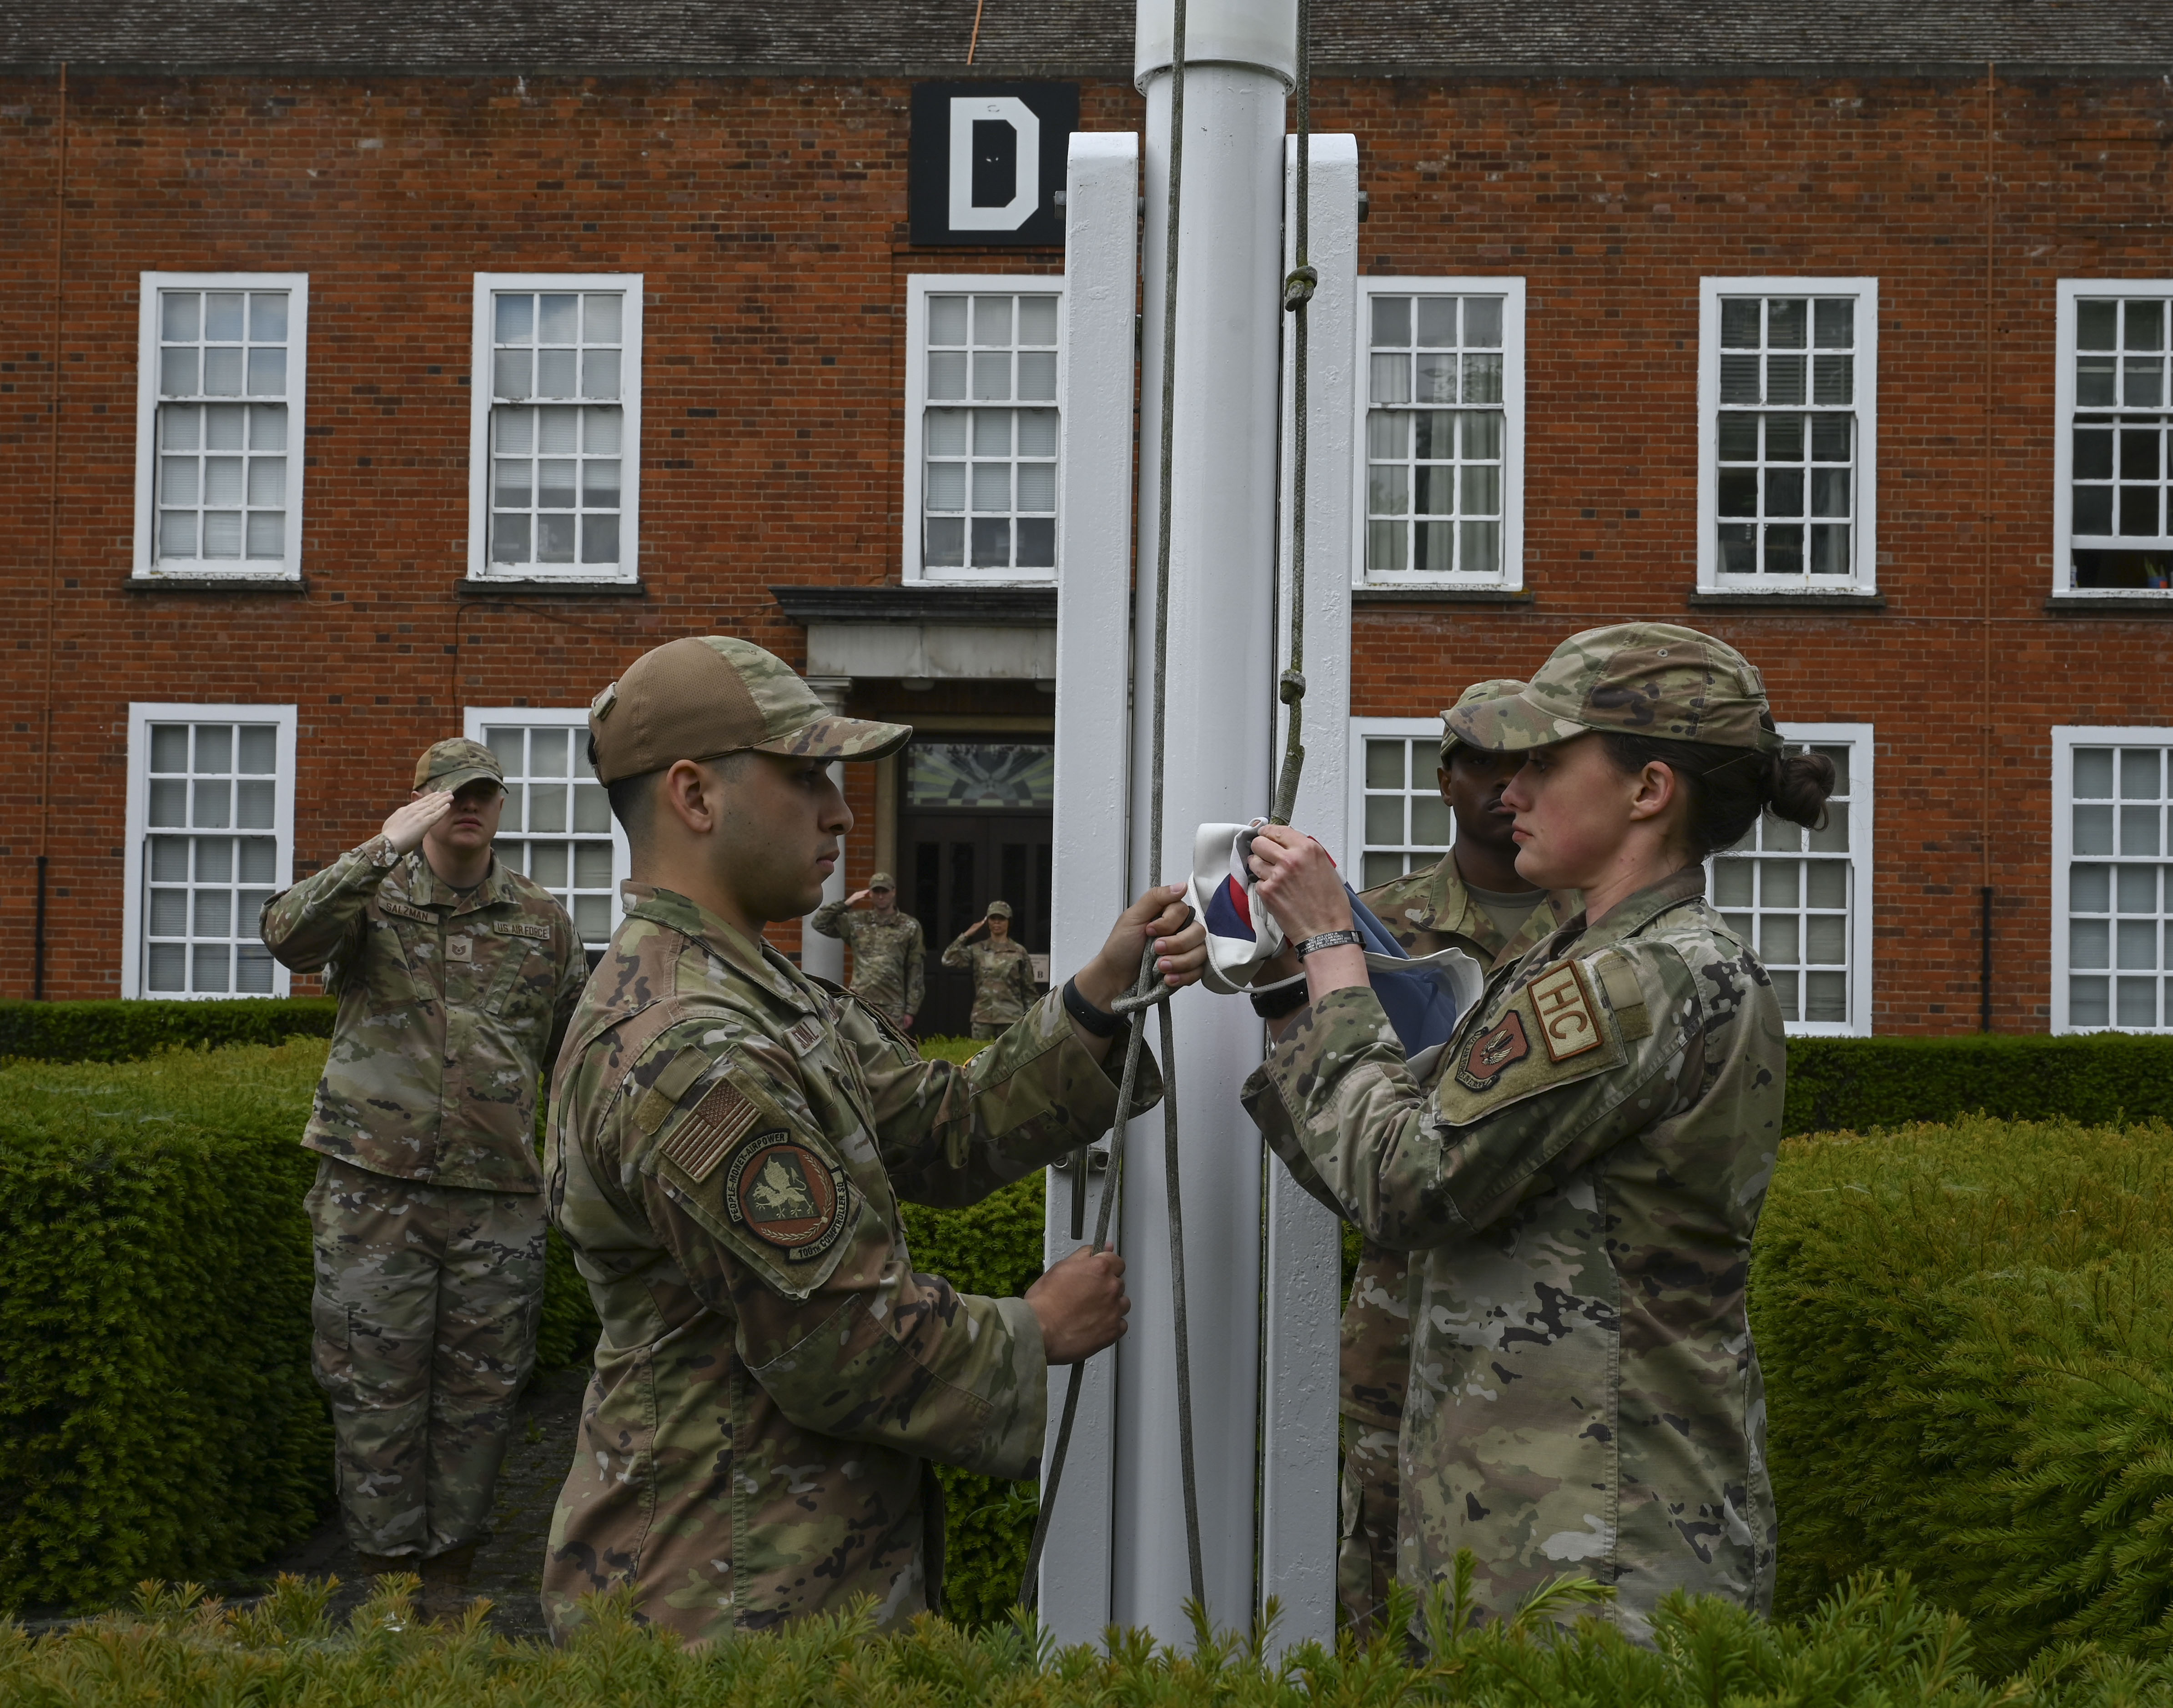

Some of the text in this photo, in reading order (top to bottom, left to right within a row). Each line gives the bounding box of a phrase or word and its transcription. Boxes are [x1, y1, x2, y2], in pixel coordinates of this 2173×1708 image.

[949, 97, 1040, 231] D
[387, 903, 428, 921] SALZMAN
[512, 924, 523, 934] AIR
[524, 926, 547, 938] FORCE
[1538, 979, 1588, 1040] HC
[820, 1196, 845, 1247] COMPTROLLER
